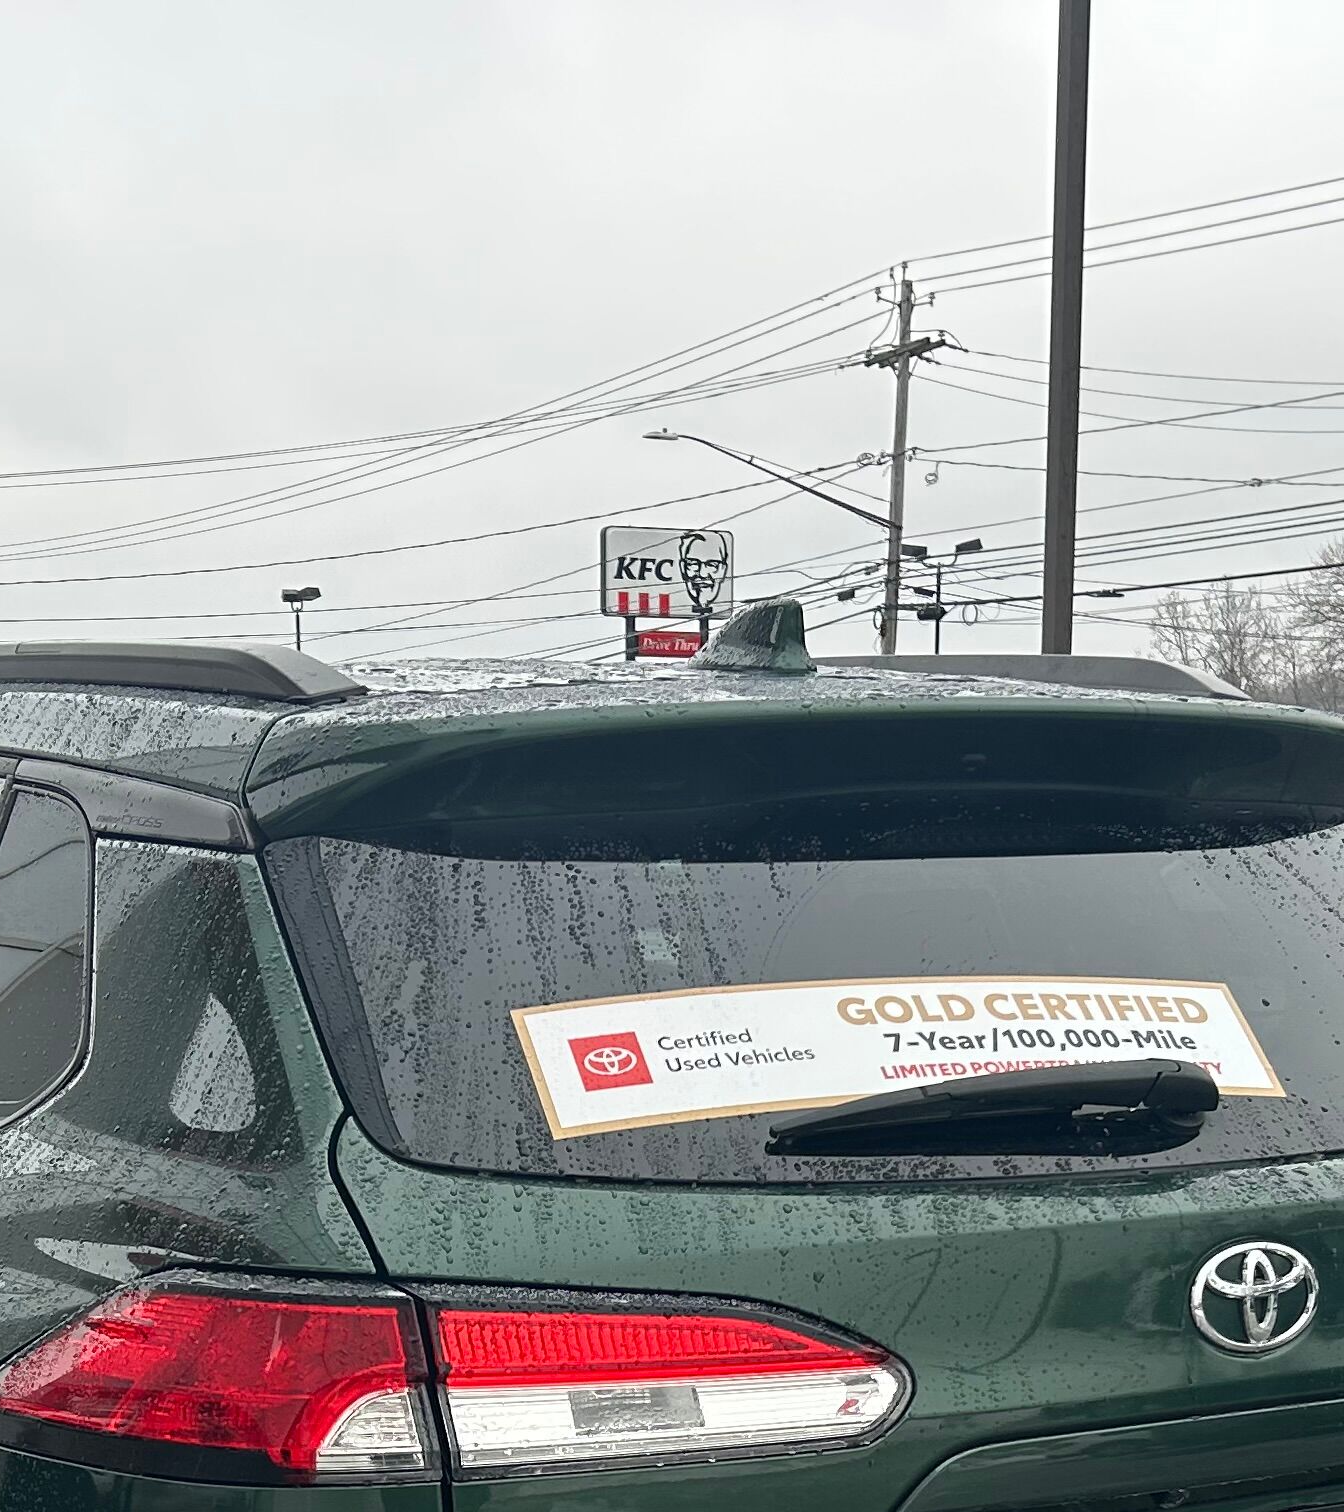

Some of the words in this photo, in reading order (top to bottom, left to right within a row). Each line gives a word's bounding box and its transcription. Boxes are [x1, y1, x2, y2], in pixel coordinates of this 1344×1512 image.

[613, 556, 674, 582] KFC
[642, 637, 671, 651] Drive
[836, 994, 976, 1026] GOLD
[983, 993, 1209, 1024] CERTIFIED
[657, 1028, 753, 1051] Certified
[883, 1027, 1197, 1053] 7-Year/100,000-Mile
[665, 1053, 722, 1073] Used
[726, 1046, 815, 1067] Vehicles
[880, 1062, 967, 1080] LIMITED
